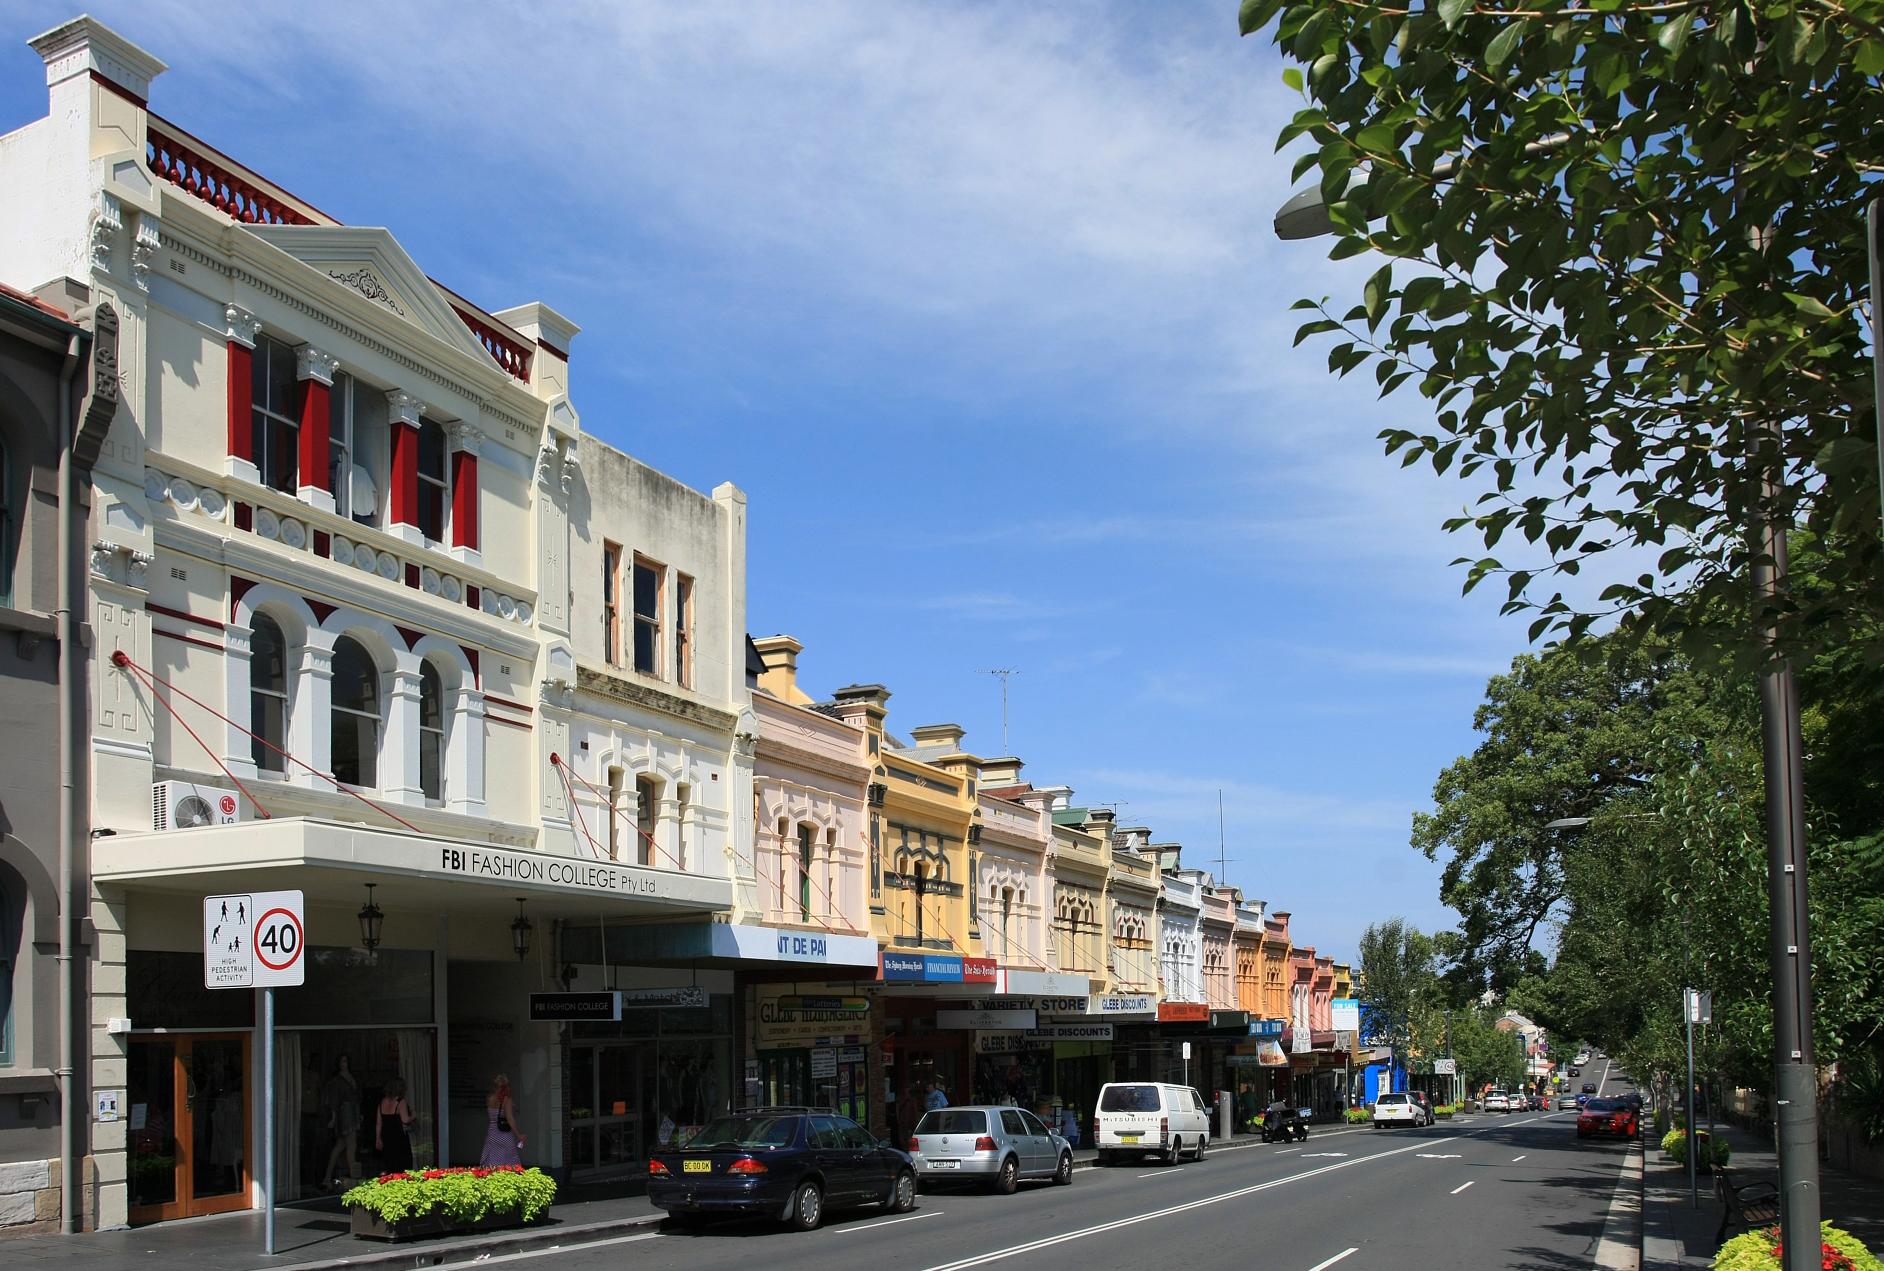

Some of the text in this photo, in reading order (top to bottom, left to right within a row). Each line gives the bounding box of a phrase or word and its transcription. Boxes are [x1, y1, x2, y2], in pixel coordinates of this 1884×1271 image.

[221, 816, 235, 825] LG
[442, 849, 656, 895] FBI FASHION COLLEGE Pty Ltd
[261, 924, 296, 954] 40
[793, 937, 807, 955] DE
[211, 966, 248, 974] PEDESTRIAN
[927, 962, 961, 975] FINANCIAL REVIEW
[215, 974, 243, 982] ACTIVITY
[644, 992, 676, 1003] Match
[534, 1002, 609, 1011] FBI FASHION COLLEGE
[813, 999, 841, 1008] Lotteries
[982, 999, 1086, 1011] VARIETY STORE
[1102, 998, 1147, 1010] GLEBE DISCOUNTS
[486, 1022, 514, 1030] COLLEGE
[818, 1025, 846, 1033] CONFECTIONERY
[1026, 1028, 1111, 1037] GLEBE DISCOUNTS
[981, 1036, 1005, 1051] GLEBE
